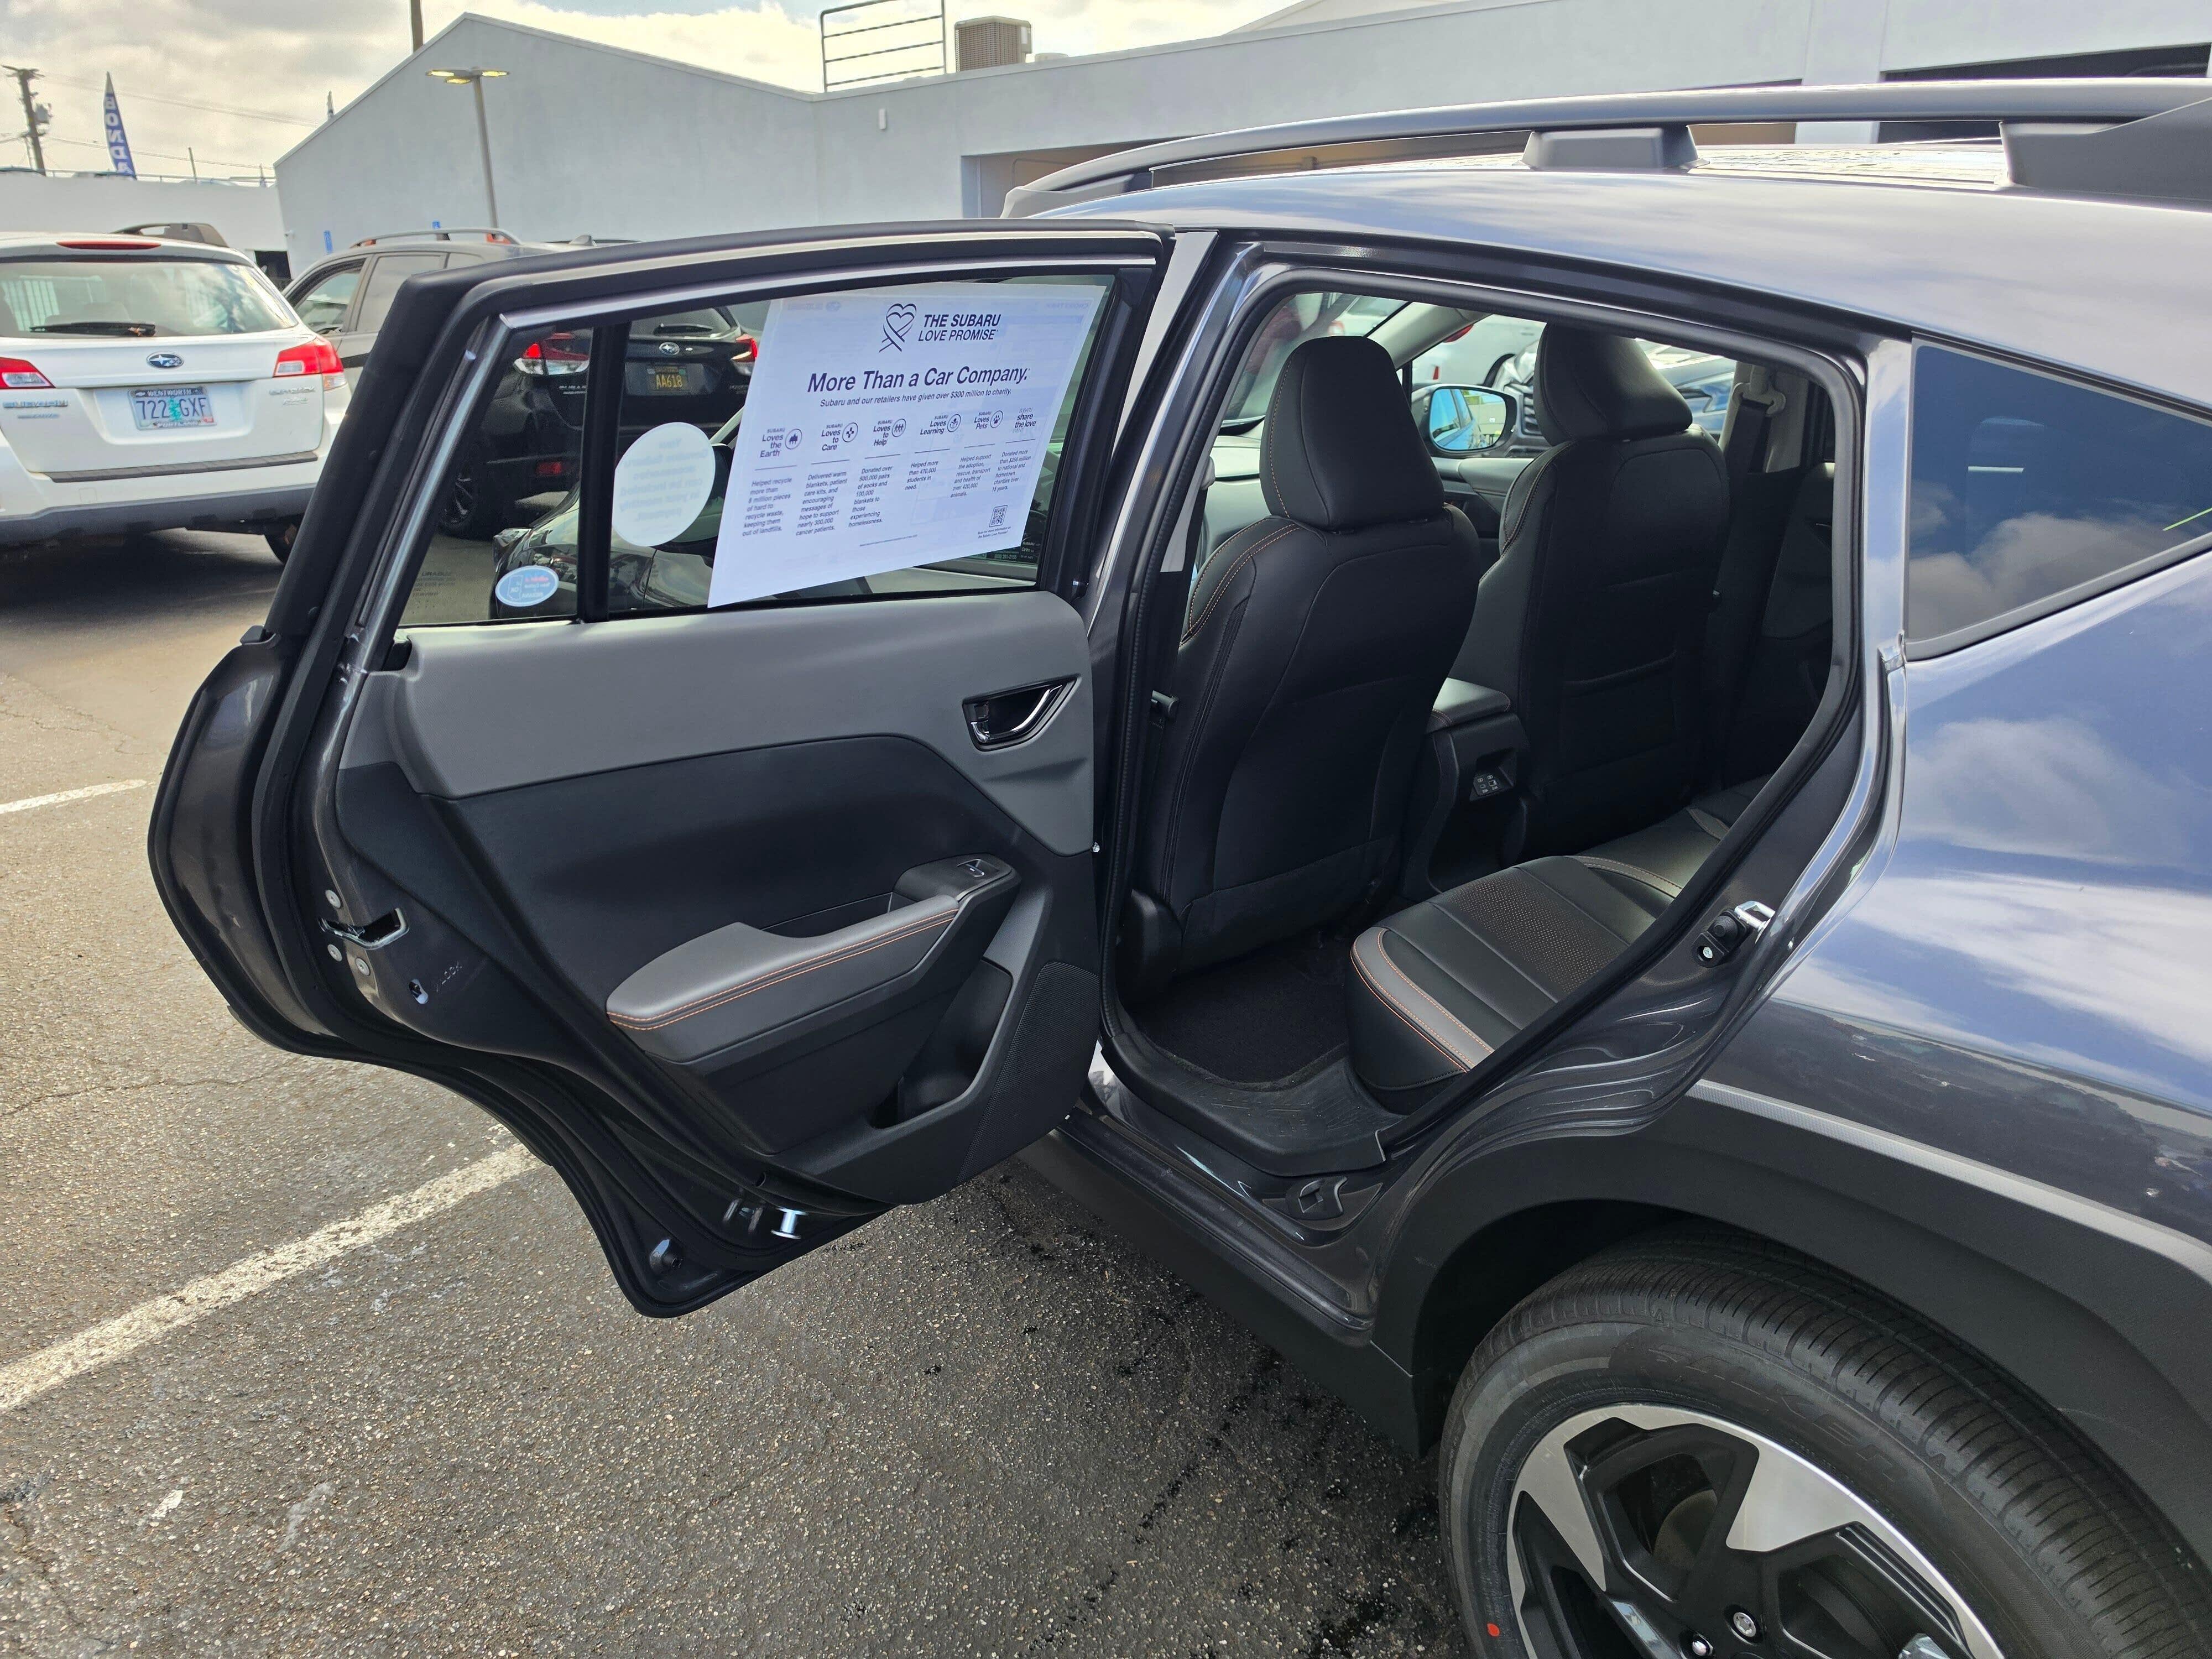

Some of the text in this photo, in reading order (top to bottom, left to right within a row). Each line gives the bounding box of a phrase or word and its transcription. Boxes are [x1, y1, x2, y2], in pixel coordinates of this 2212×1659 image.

[924, 314, 1001, 327] THE SUBARU
[918, 329, 996, 341] LOVE PROMISE
[656, 374, 682, 389] AA618
[807, 366, 1027, 393] More Than a Car Company.
[820, 399, 846, 407] Subaru
[847, 398, 860, 406] and
[874, 395, 900, 404] retailers
[902, 394, 916, 402] have
[918, 393, 935, 403] given
[950, 390, 964, 399] $300
[965, 389, 984, 398] million
[992, 388, 1011, 397] charity.
[136, 392, 206, 419] 722 GXF
[920, 427, 944, 436] Learning
[762, 434, 784, 442] Loves
[802, 496, 834, 504] encouraging
[820, 509, 839, 518] support
[851, 512, 880, 520] experiencing
[848, 519, 883, 527] homelessness.
